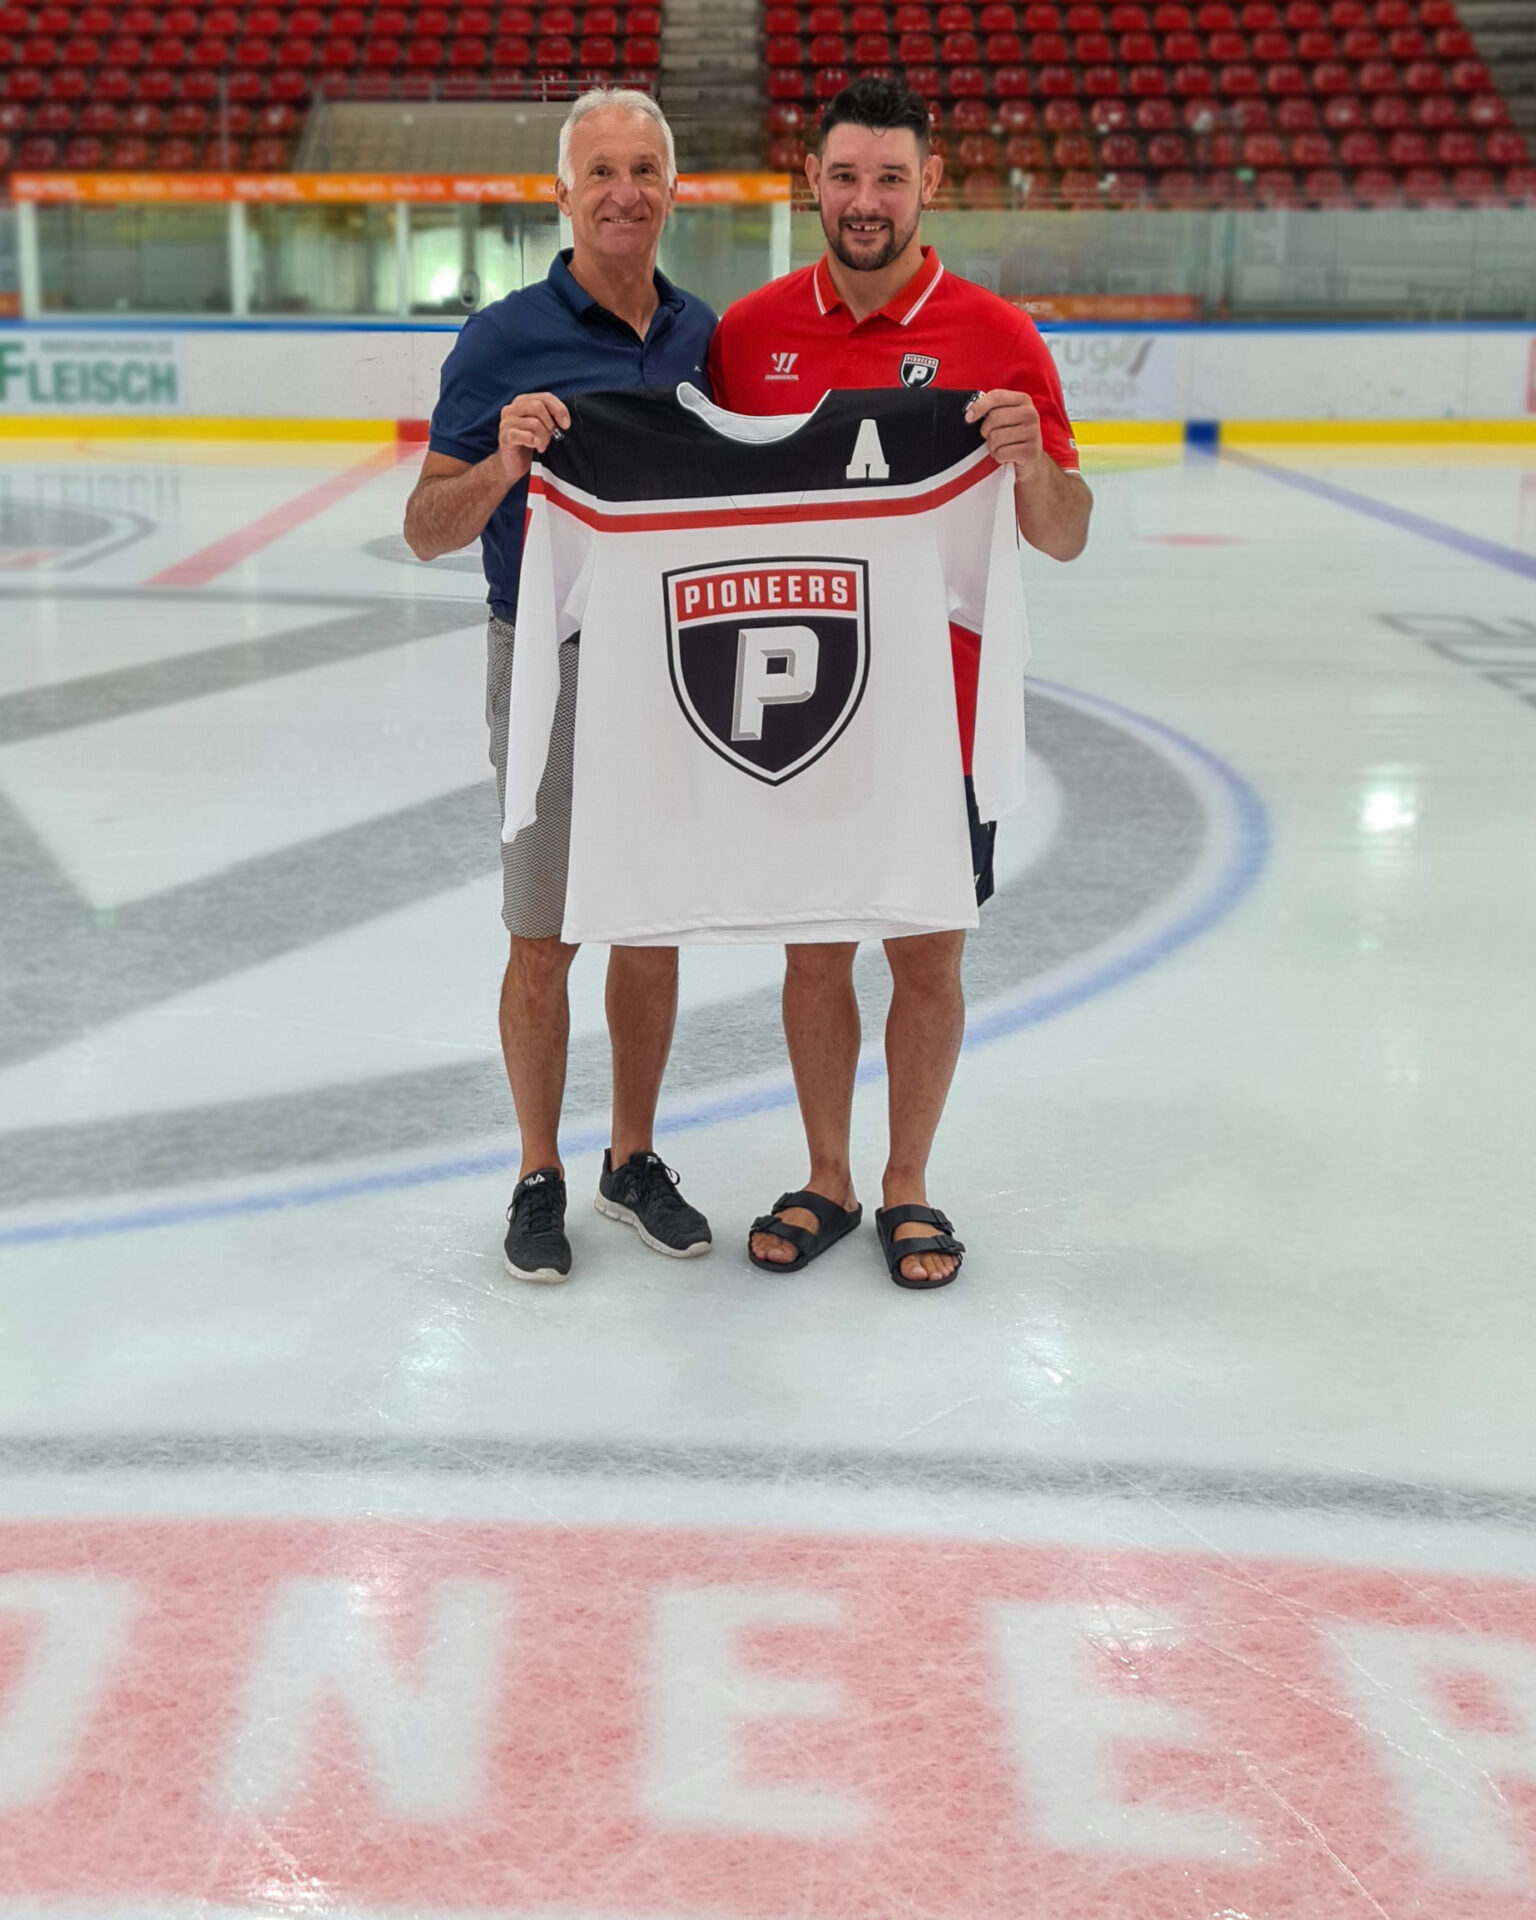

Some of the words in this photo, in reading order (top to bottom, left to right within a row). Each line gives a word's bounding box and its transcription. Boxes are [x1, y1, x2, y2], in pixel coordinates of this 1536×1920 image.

[0, 340, 178, 404] FLEISCH
[846, 418, 890, 479] A
[684, 575, 849, 614] PIONEERS
[730, 624, 820, 742] P
